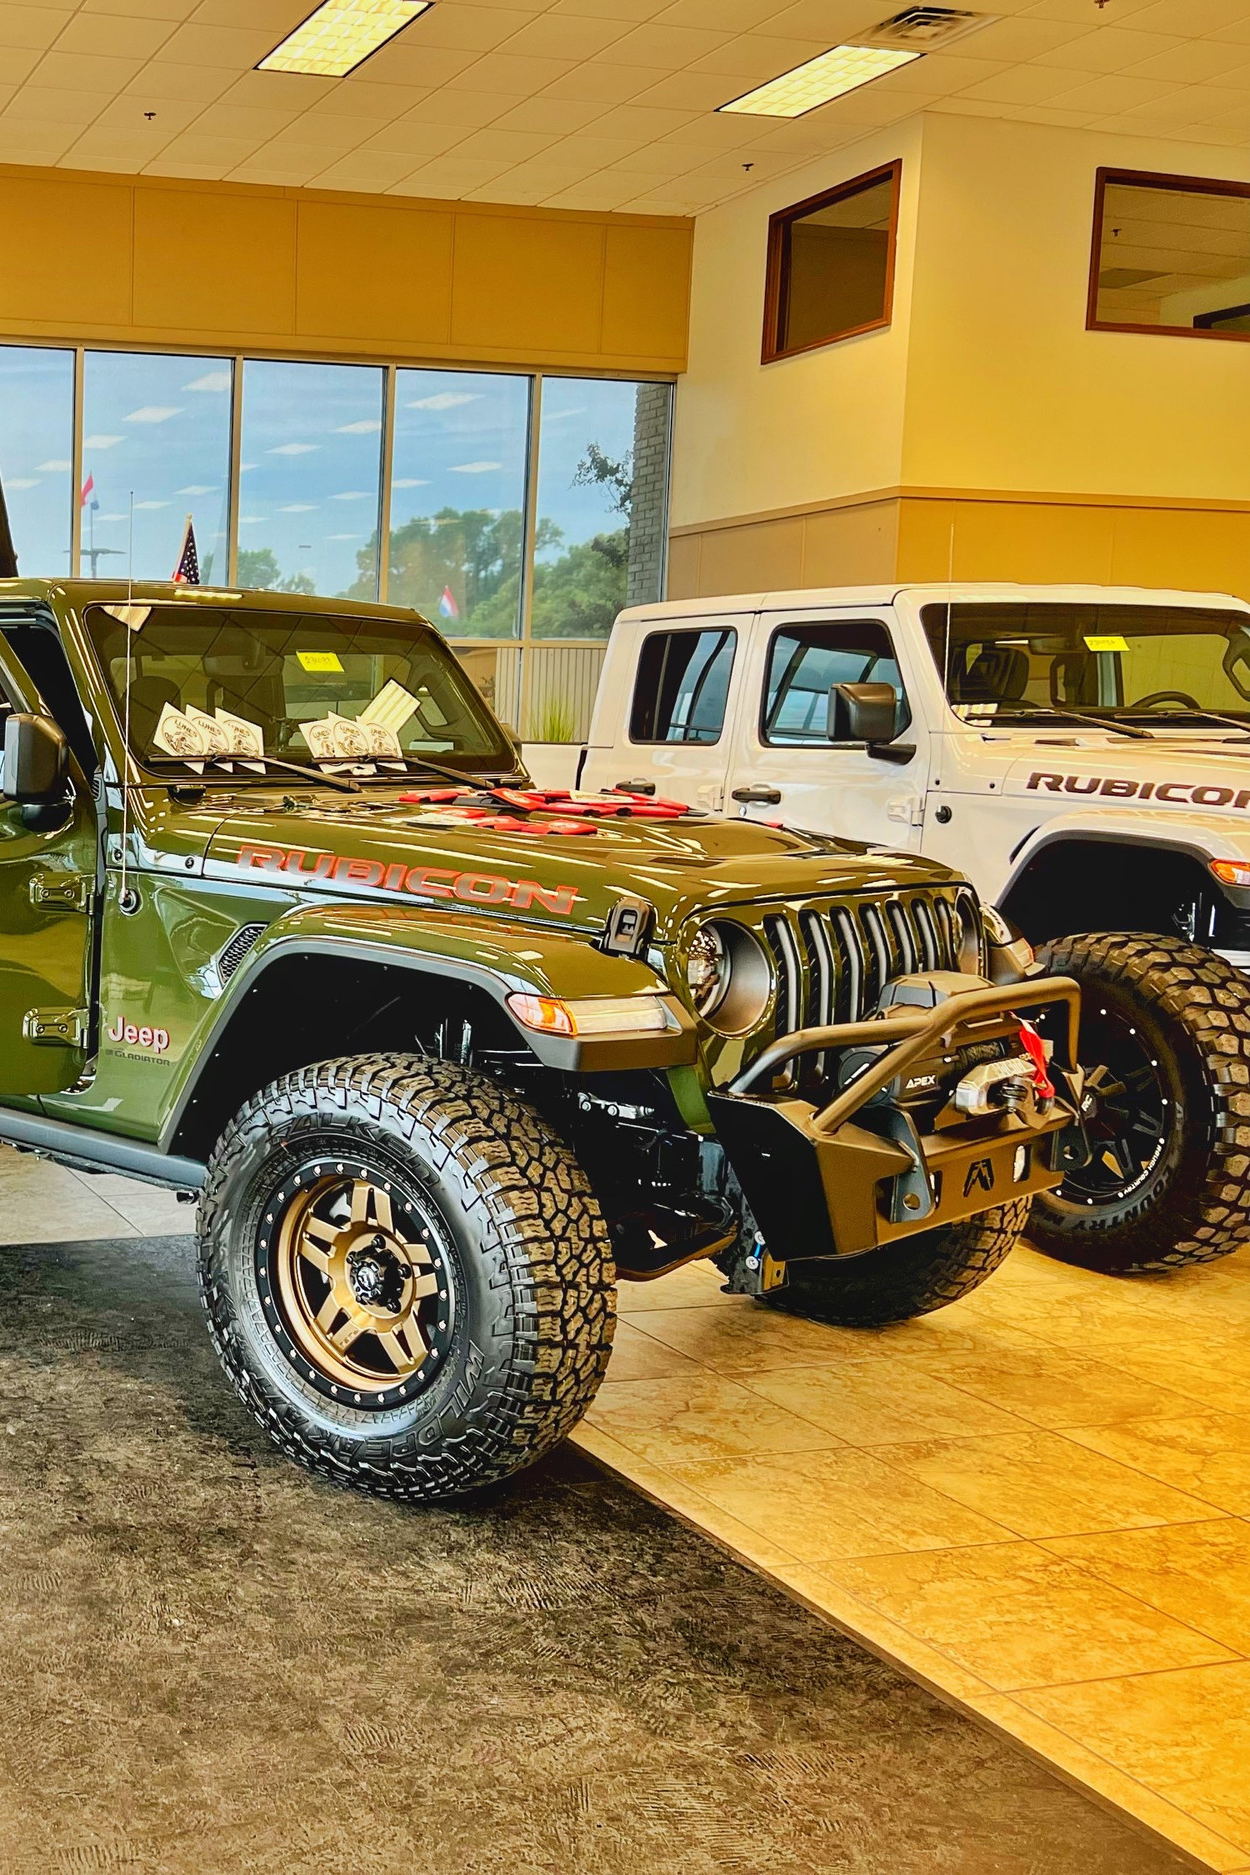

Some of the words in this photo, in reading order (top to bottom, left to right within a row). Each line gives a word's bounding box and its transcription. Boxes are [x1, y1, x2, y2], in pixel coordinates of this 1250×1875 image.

[237, 845, 579, 915] RUBICON
[108, 1015, 170, 1054] Jeep
[115, 1050, 170, 1066] GLADIATOR
[905, 1074, 937, 1089] APEX
[1123, 1169, 1149, 1195] COUNTRY
